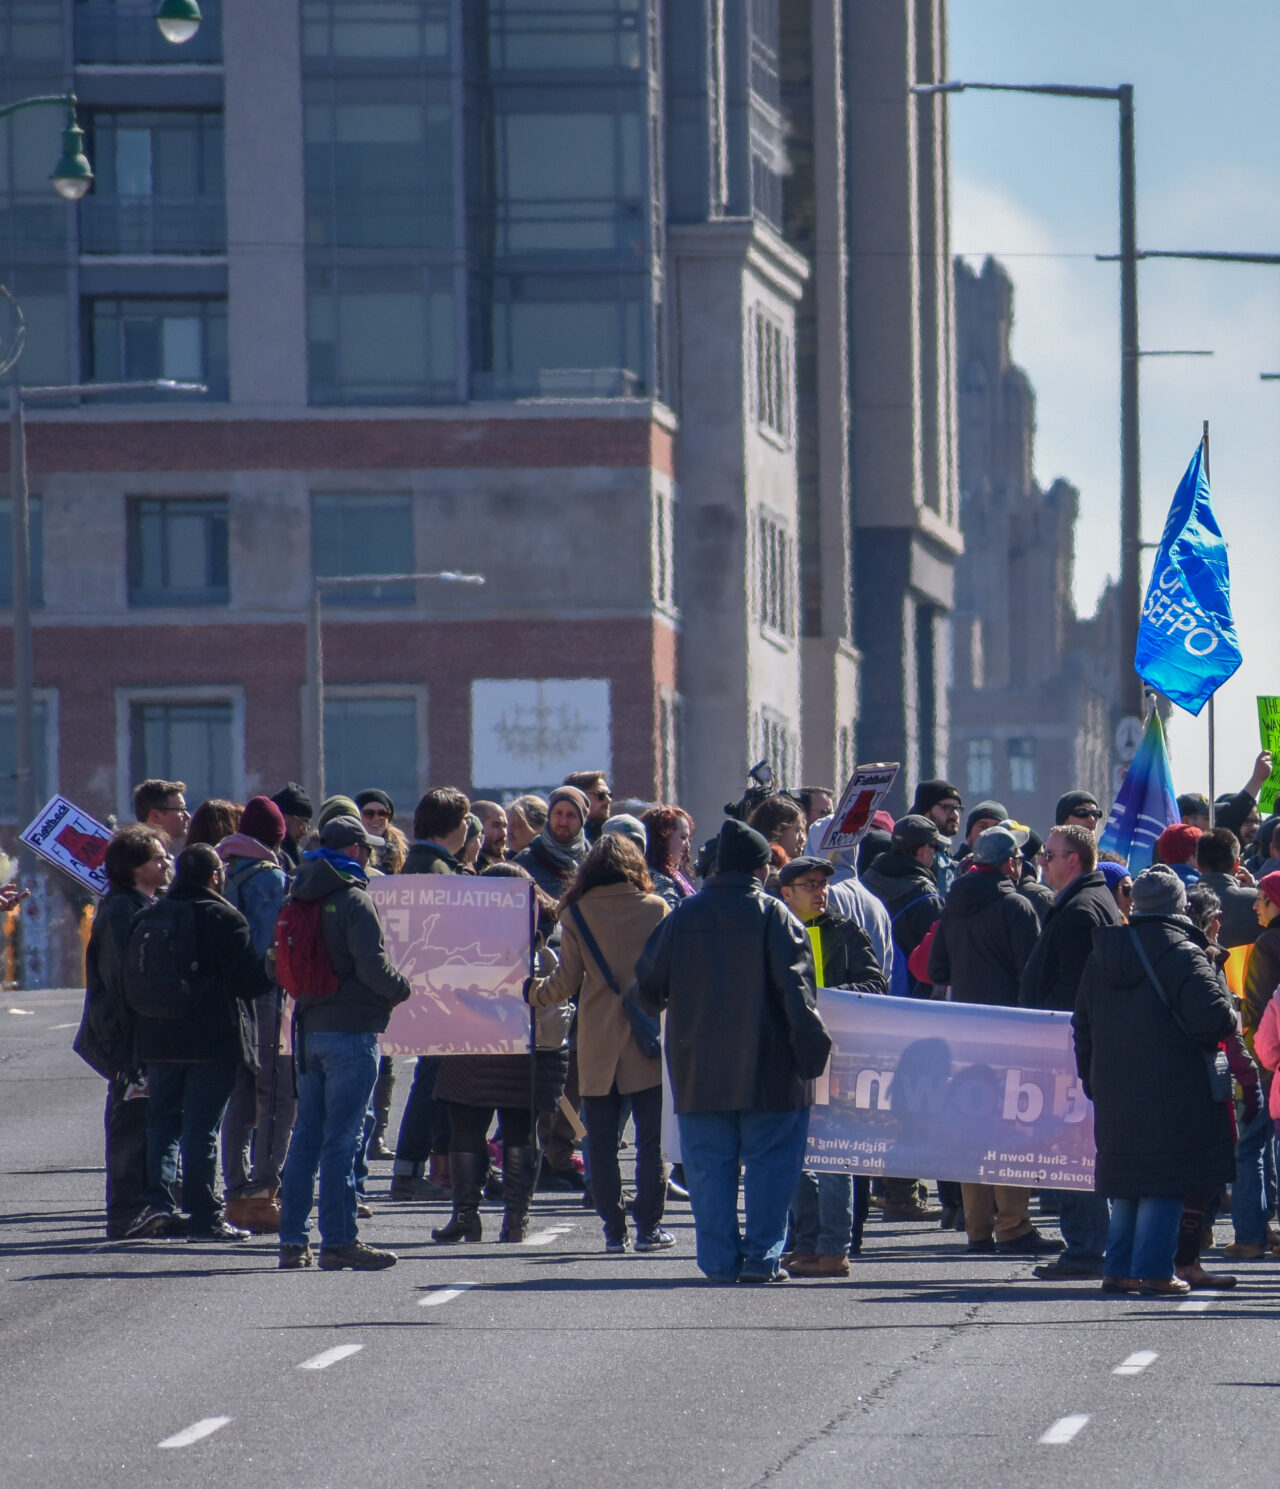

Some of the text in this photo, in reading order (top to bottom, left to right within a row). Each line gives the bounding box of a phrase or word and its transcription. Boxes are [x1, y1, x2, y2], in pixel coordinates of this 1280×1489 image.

[1143, 588, 1219, 656] SEFPO
[1260, 697, 1280, 715] THE
[1262, 718, 1280, 733] WAY
